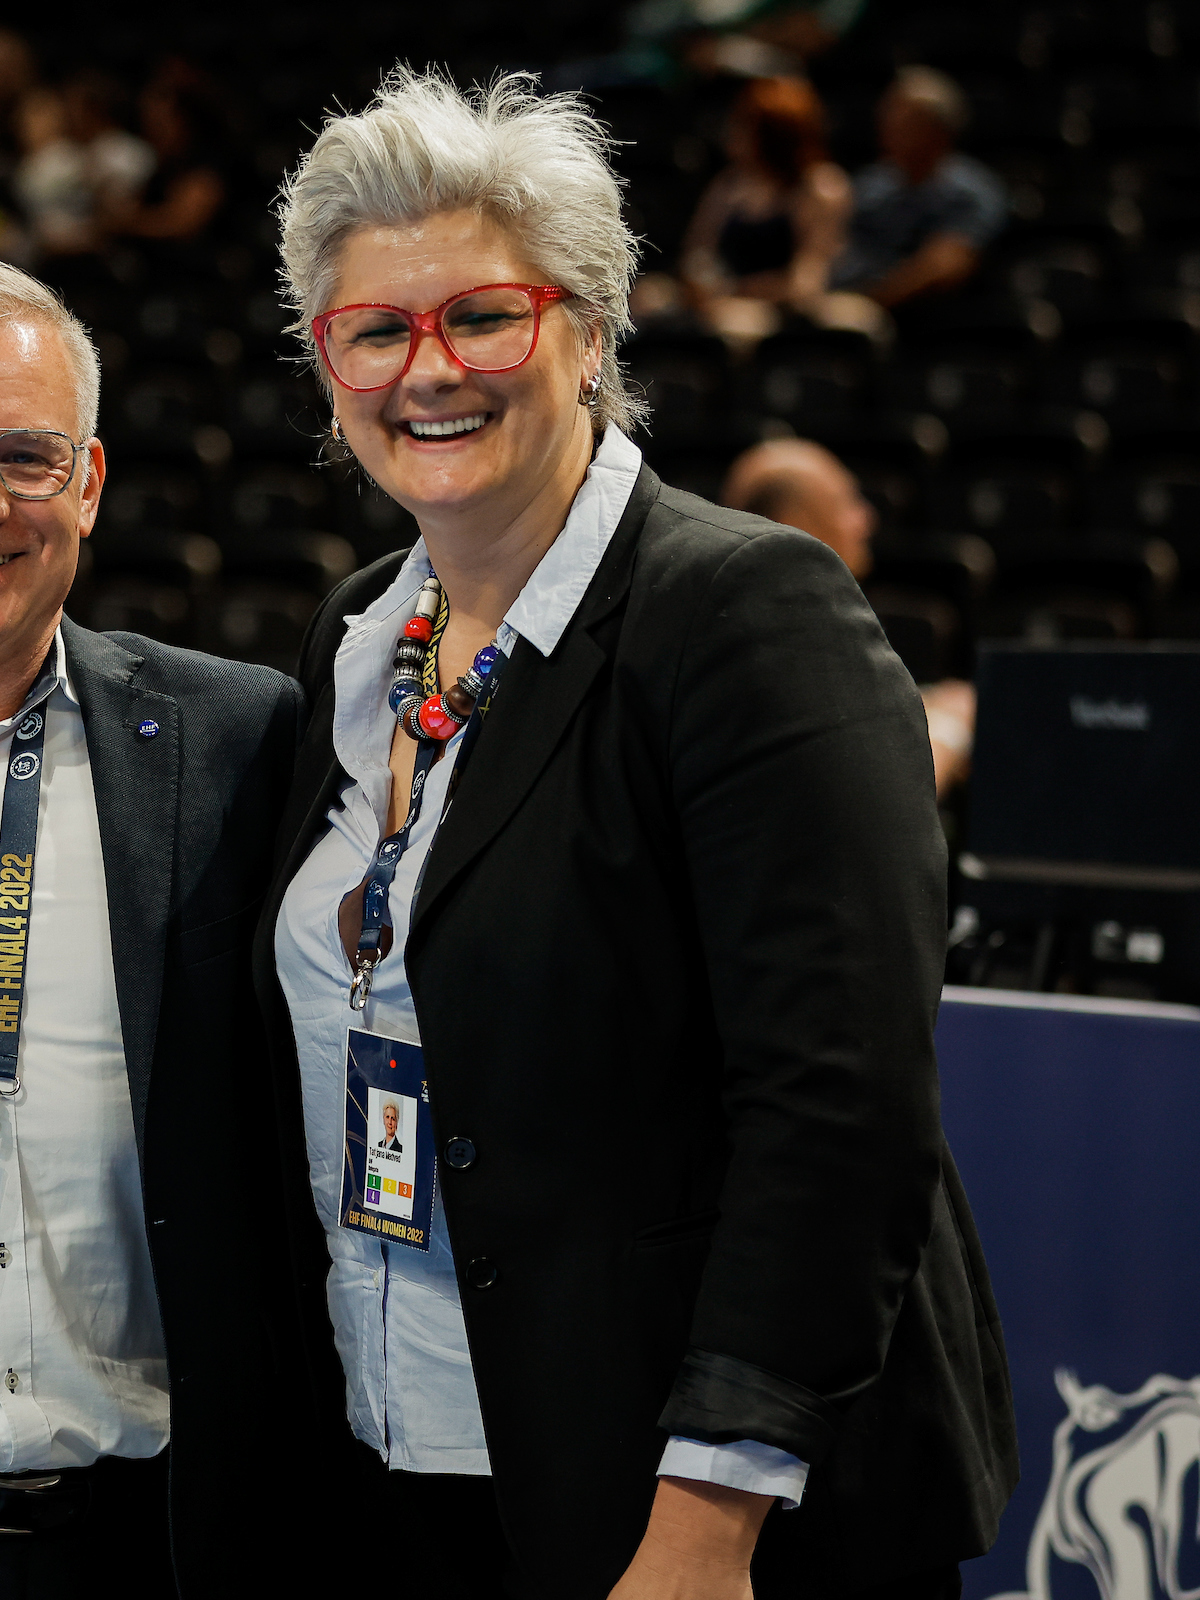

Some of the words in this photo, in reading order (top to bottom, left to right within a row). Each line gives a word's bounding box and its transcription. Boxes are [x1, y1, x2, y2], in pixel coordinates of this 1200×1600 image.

[387, 1180, 392, 1191] 2
[402, 1184, 408, 1195] 3
[349, 1210, 360, 1225] EHF
[360, 1213, 382, 1231] FINAL4
[382, 1218, 406, 1239] WOMEN
[407, 1226, 423, 1244] 2022
